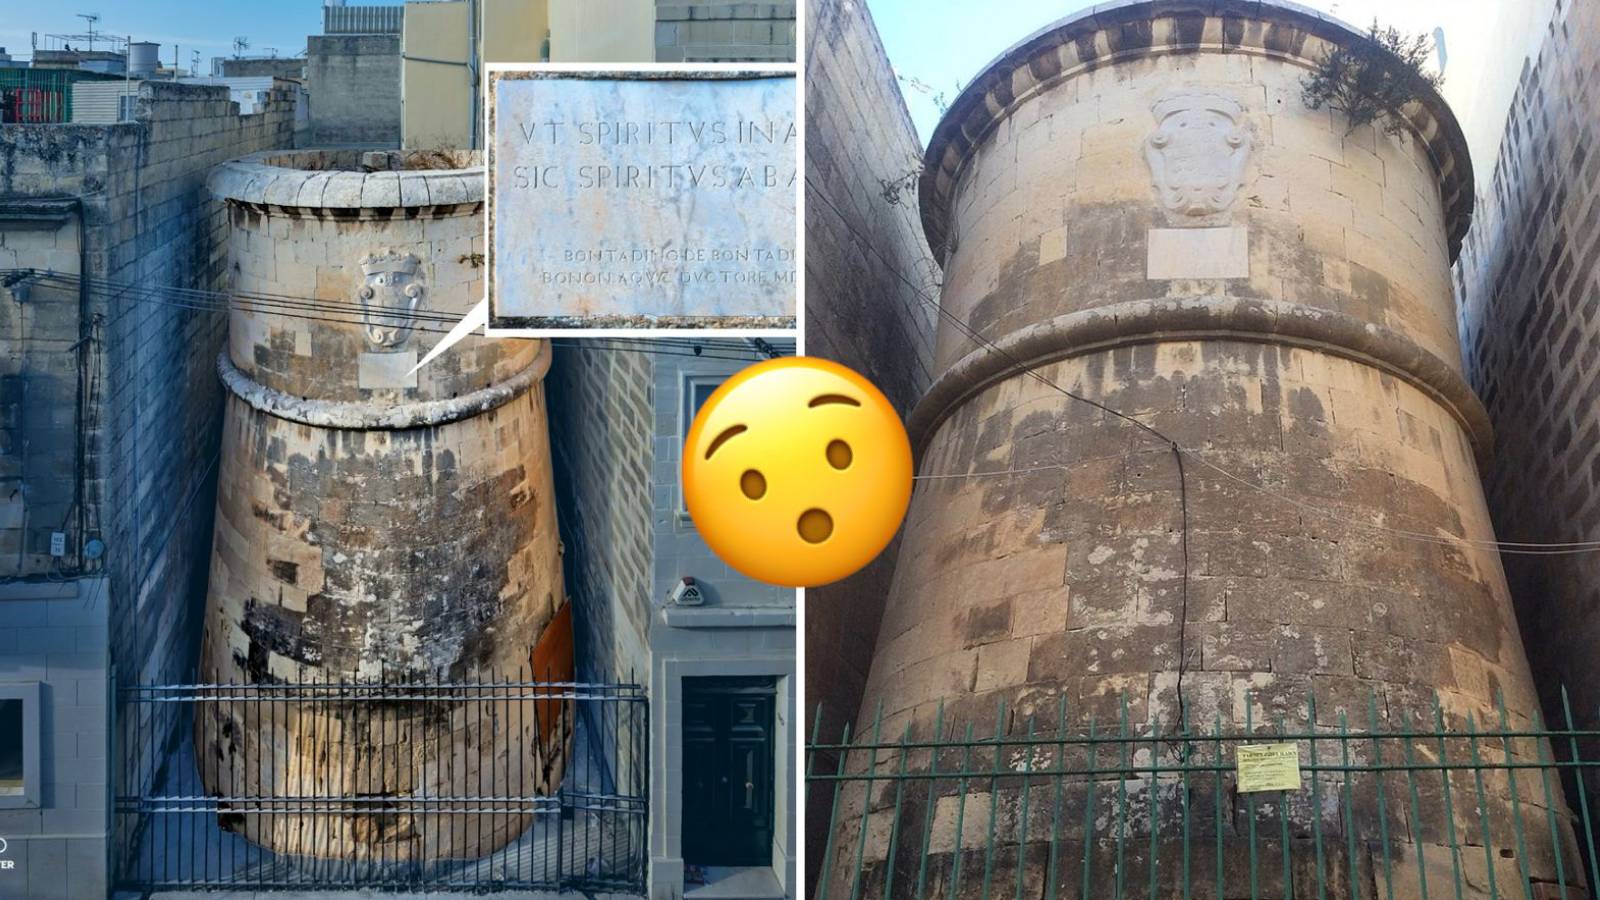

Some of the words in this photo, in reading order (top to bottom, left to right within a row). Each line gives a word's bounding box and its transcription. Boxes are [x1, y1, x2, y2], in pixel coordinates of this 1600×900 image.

[579, 121, 727, 144] SPIRITVS
[514, 165, 558, 188] SIC
[579, 165, 727, 188] SPIRITVS
